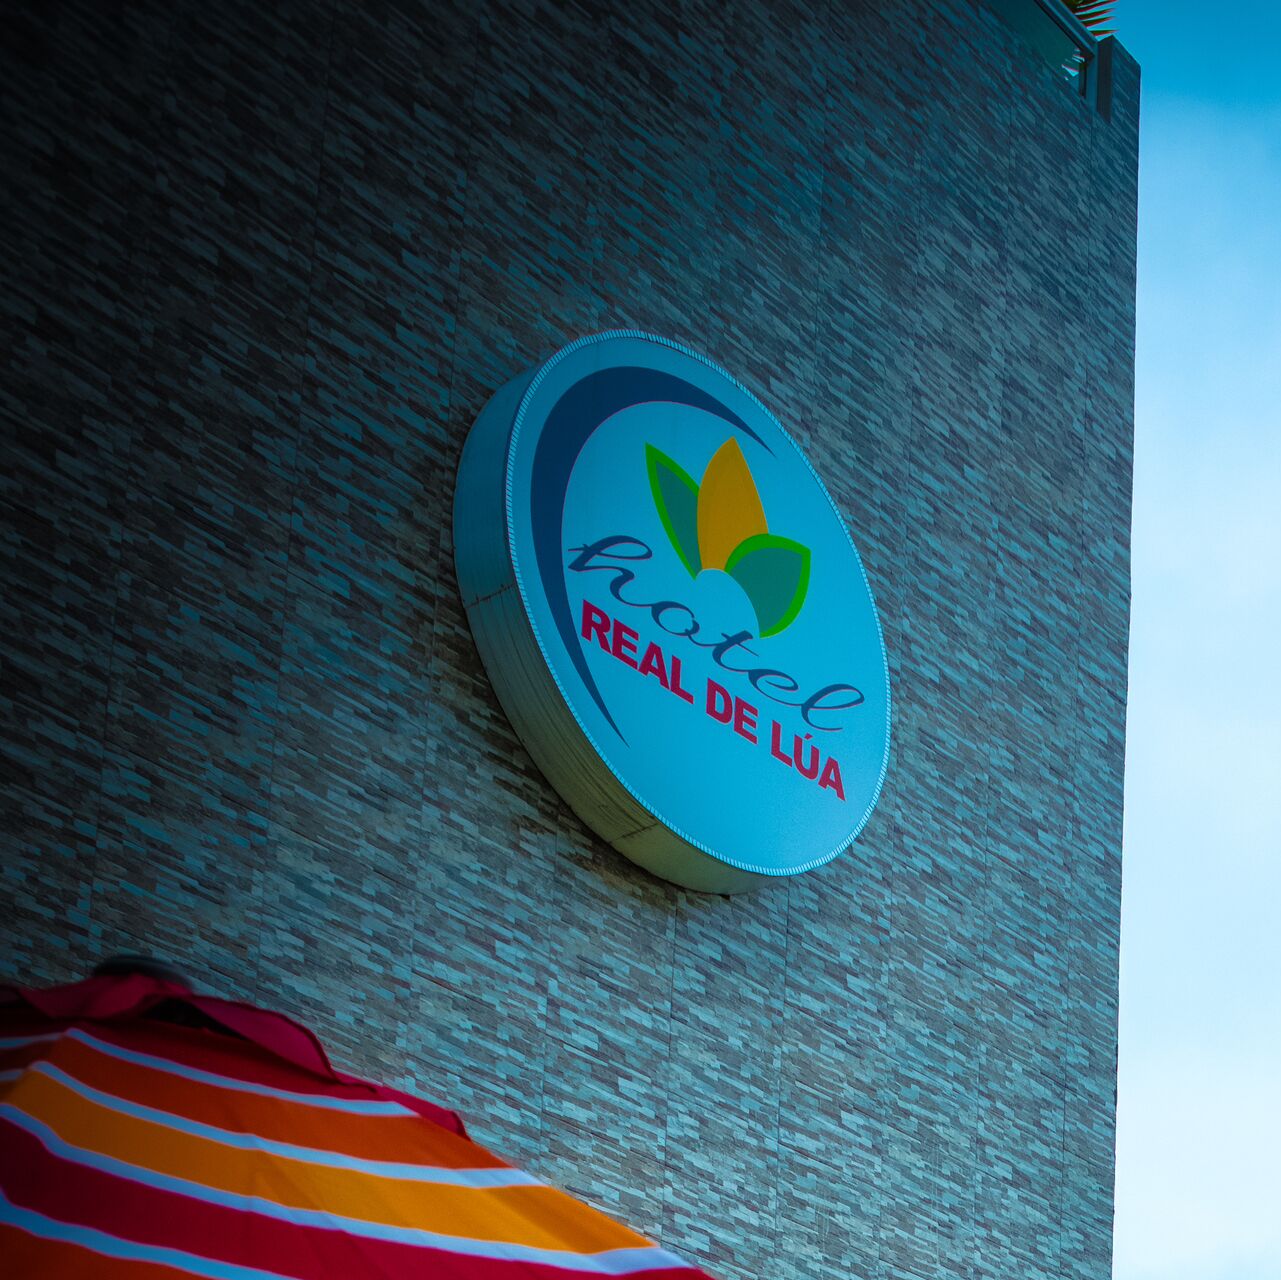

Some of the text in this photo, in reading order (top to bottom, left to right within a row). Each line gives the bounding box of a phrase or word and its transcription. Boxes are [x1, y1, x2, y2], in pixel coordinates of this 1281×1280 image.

[568, 535, 865, 731] hotel
[581, 598, 846, 801] REAL DE LÚA
